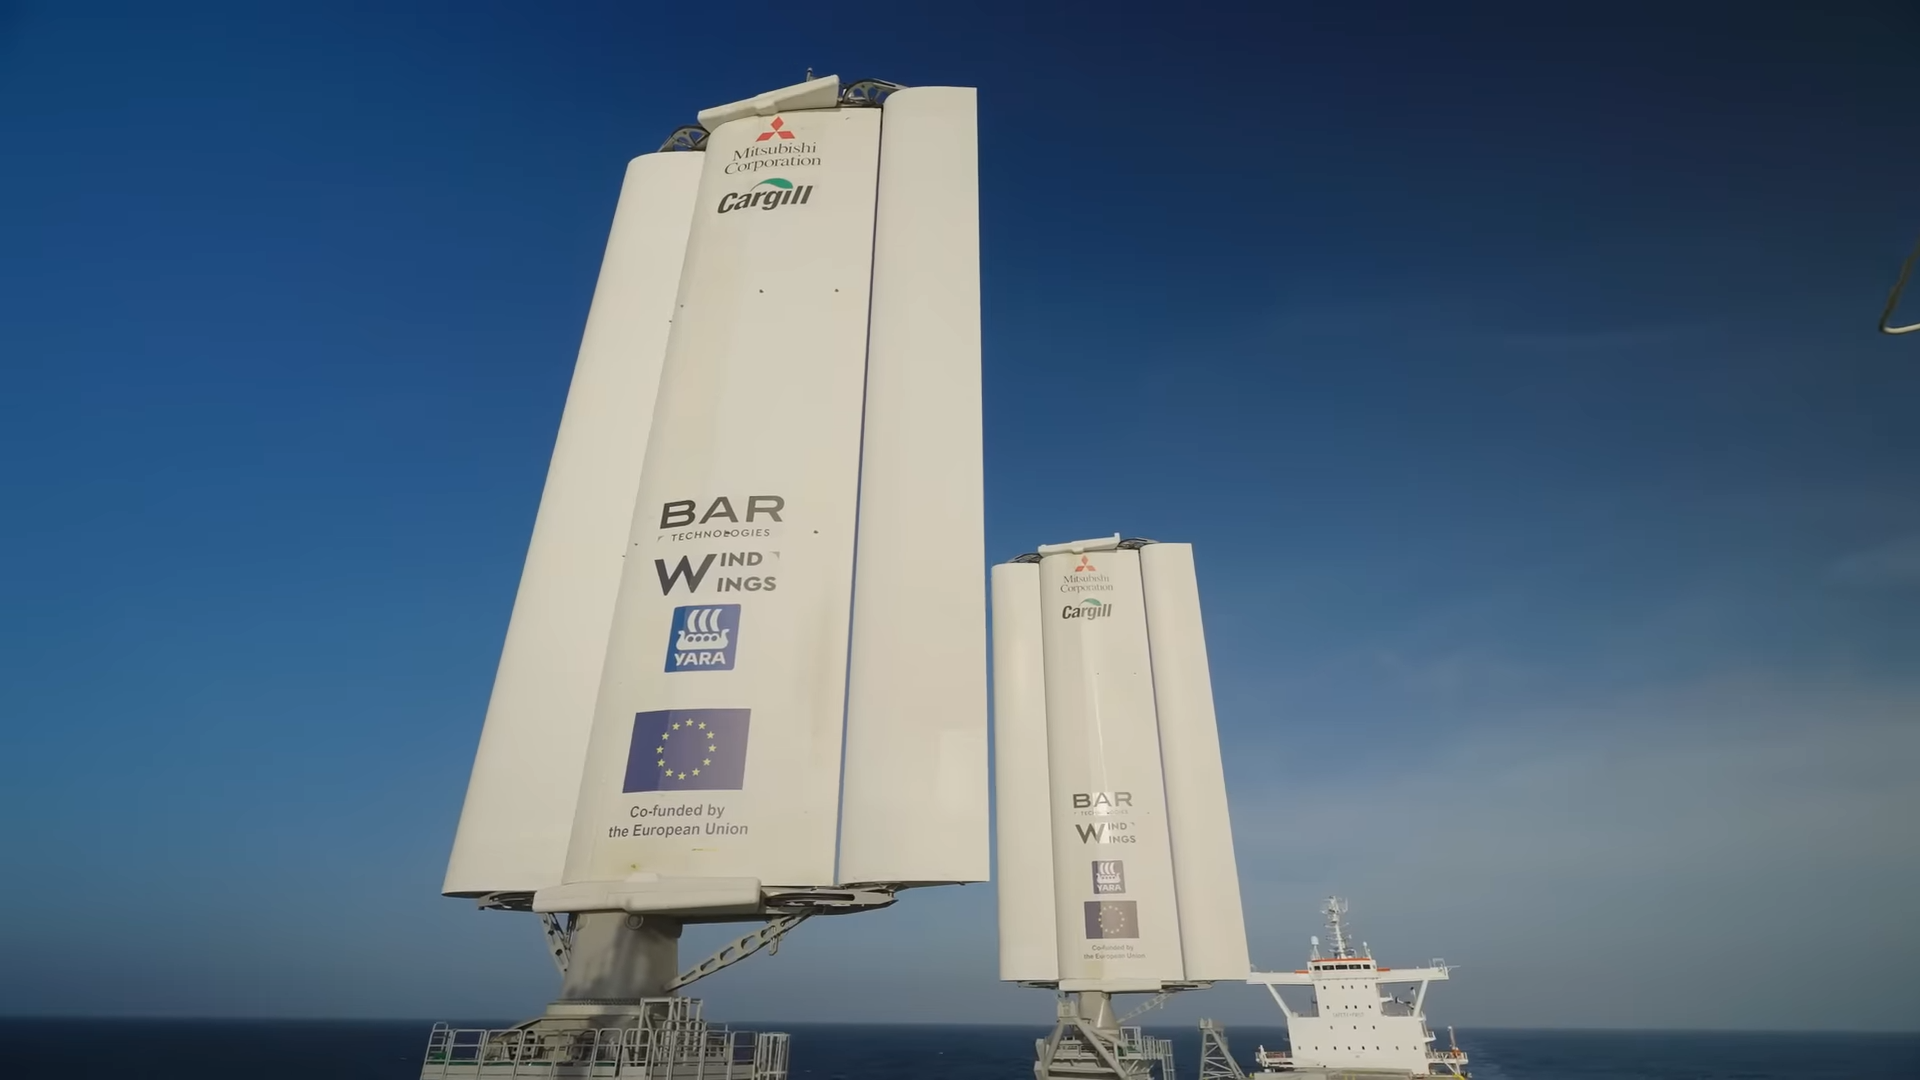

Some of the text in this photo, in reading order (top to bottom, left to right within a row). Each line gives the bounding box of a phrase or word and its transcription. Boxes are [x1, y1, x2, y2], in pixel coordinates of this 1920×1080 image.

[733, 142, 817, 161] Mitsubishi
[724, 155, 821, 175] Corporation
[717, 185, 813, 214] Cargill
[659, 495, 785, 530] BAR
[671, 529, 770, 542] TECHNOLOGIES
[1063, 573, 1110, 584] Mitsubishi
[1060, 583, 1114, 594] Corporation
[1062, 603, 1112, 621] Cargill
[674, 651, 726, 667] YARA
[1073, 791, 1133, 809] BAR
[630, 804, 725, 819] Co-funded by
[608, 822, 749, 838] the European Union
[1096, 884, 1122, 892] YARA
